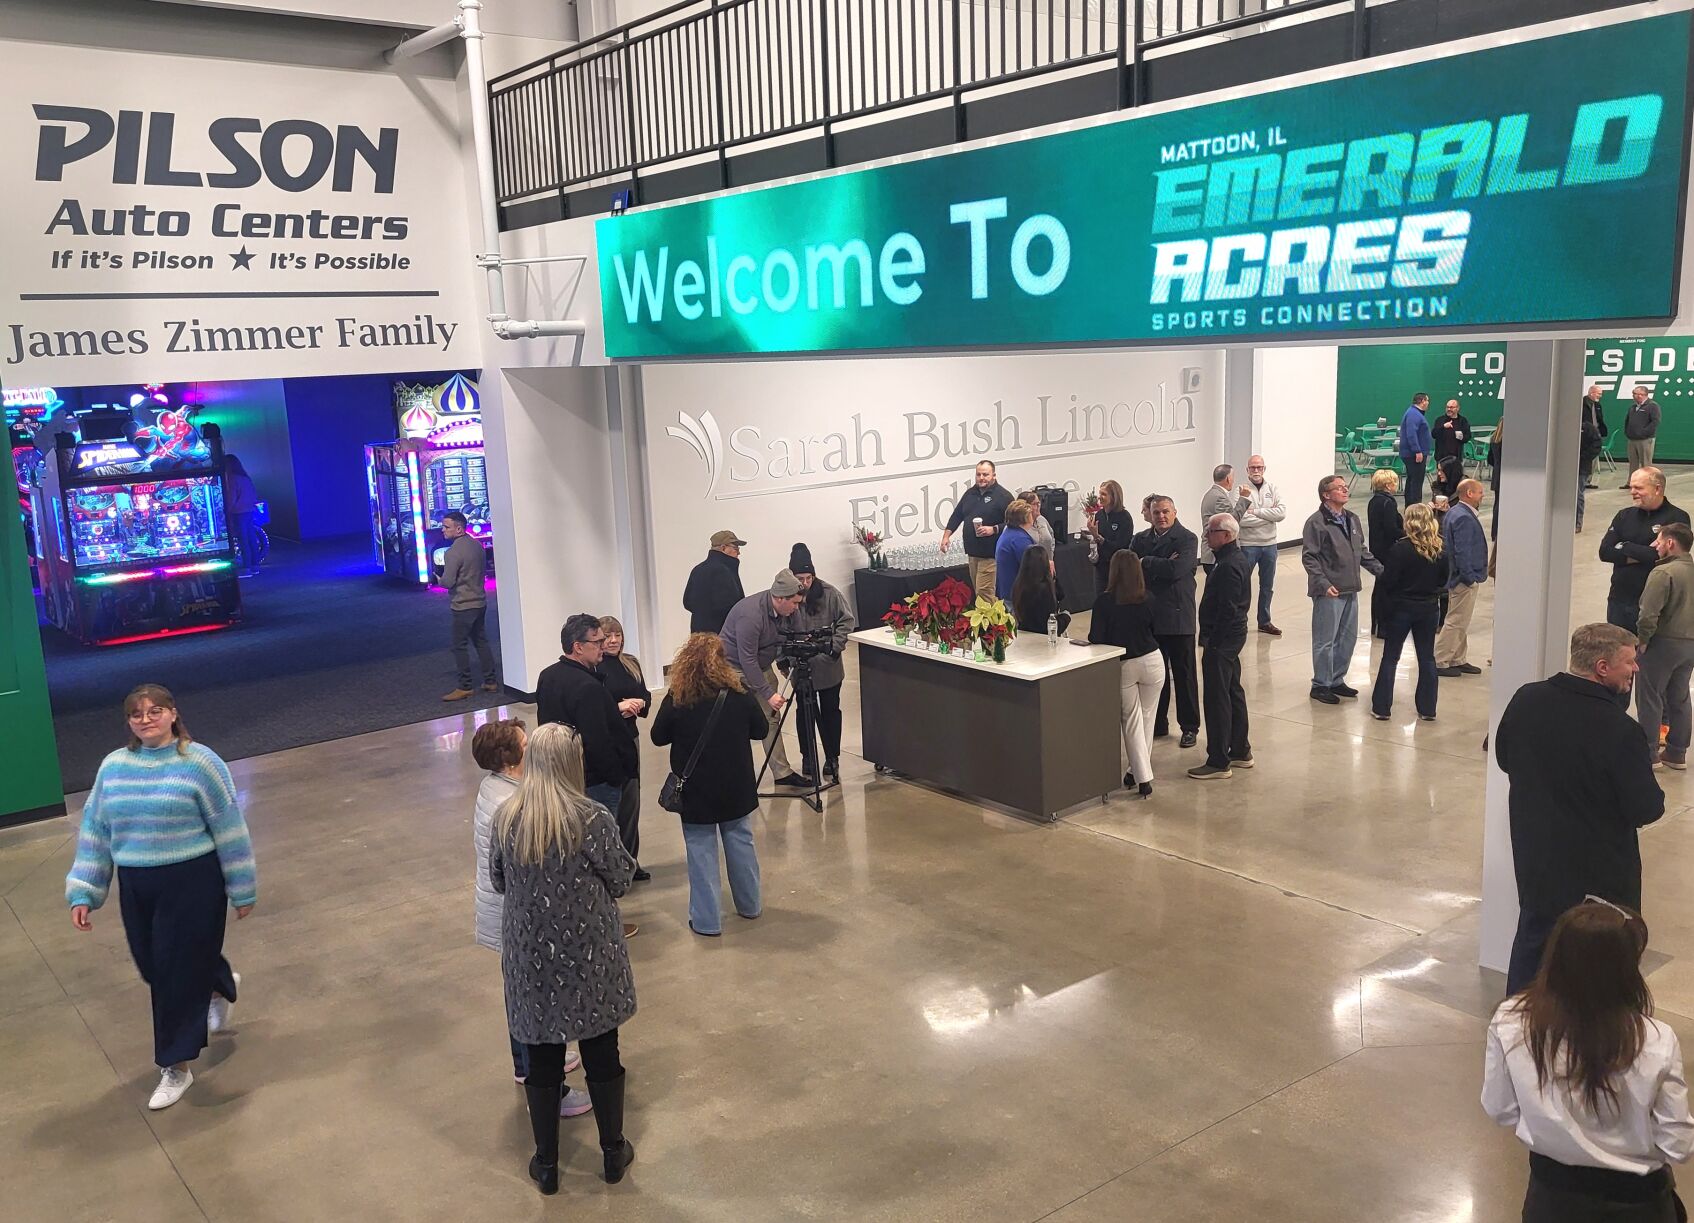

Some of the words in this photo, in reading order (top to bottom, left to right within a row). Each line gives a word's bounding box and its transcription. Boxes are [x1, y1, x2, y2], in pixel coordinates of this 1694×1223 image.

[32, 103, 399, 194] PILSON
[1151, 94, 1664, 234] EMERALD
[1161, 130, 1260, 164] MATTOON,
[1267, 126, 1287, 146] IL
[44, 199, 191, 237] Auto
[211, 203, 409, 241] Centers
[51, 250, 73, 269] If
[80, 250, 123, 270] it's
[132, 250, 213, 270] Pilson
[269, 252, 307, 270] It's
[314, 252, 411, 270] Possible
[613, 232, 926, 324] Welcome
[949, 196, 1071, 299] To
[1149, 209, 1472, 304] ACRES
[7, 324, 149, 365] James
[163, 319, 324, 353] Zimmer
[335, 314, 459, 352] Family
[1151, 307, 1247, 330] SPORTS
[1260, 296, 1449, 326] CONNECTION
[729, 412, 886, 483] Sarah
[902, 400, 1023, 463] Bush
[1036, 381, 1196, 447] Lincoln
